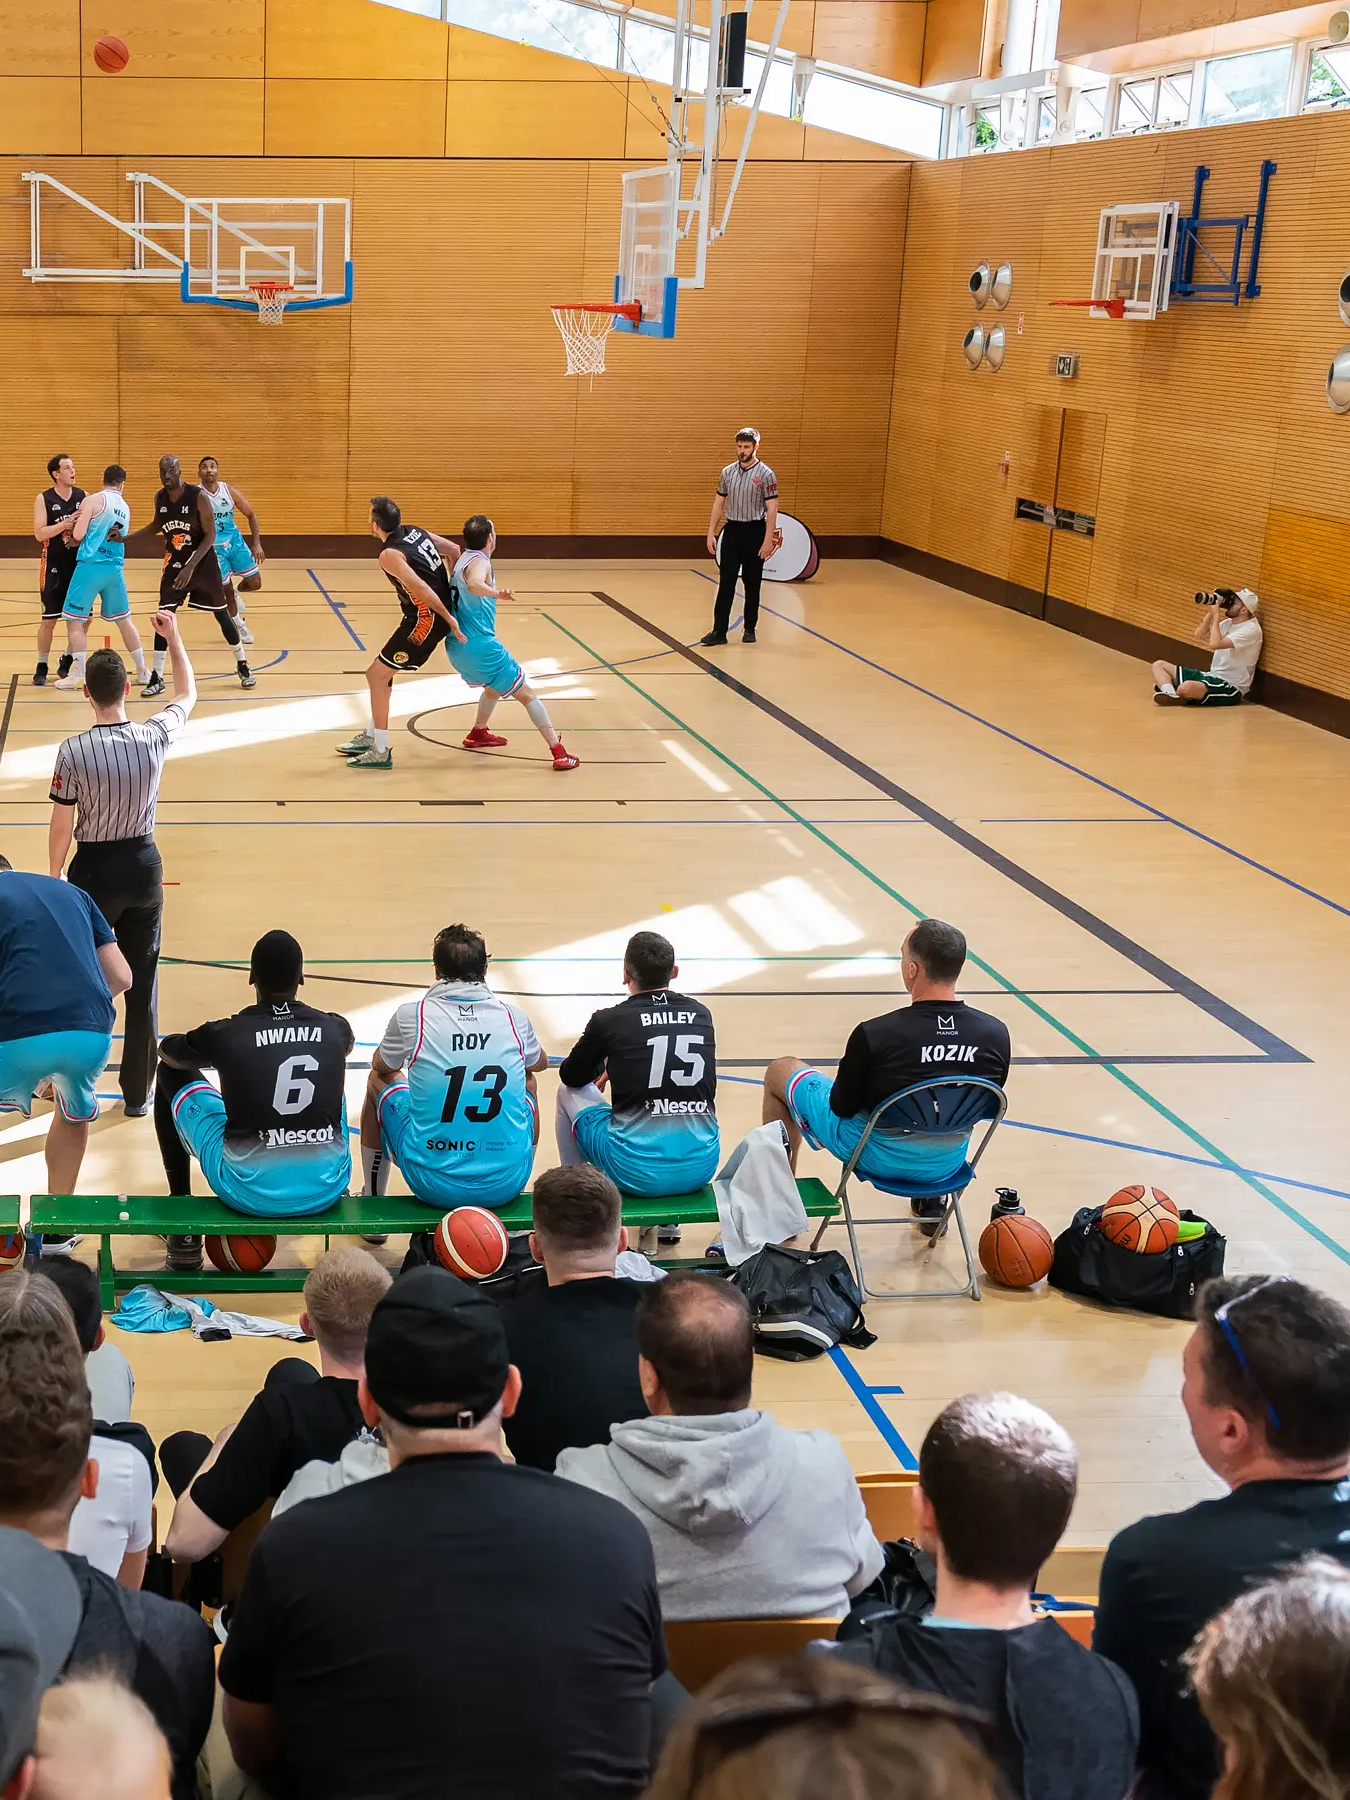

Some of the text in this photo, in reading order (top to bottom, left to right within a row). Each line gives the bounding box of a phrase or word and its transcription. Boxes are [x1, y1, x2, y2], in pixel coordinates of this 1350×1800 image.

[162, 520, 191, 533] TIGERS
[418, 539, 442, 571] 13
[640, 1011, 697, 1027] BAILEY
[256, 1026, 322, 1047] NWANA
[452, 1033, 491, 1051] ROY
[646, 1034, 706, 1089] 15
[920, 1044, 979, 1063] KOZIK
[272, 1054, 319, 1115] 6
[440, 1065, 508, 1123] 13
[651, 1099, 710, 1115] Nescot
[266, 1124, 334, 1147] Nescot
[426, 1139, 476, 1151] SONIC
